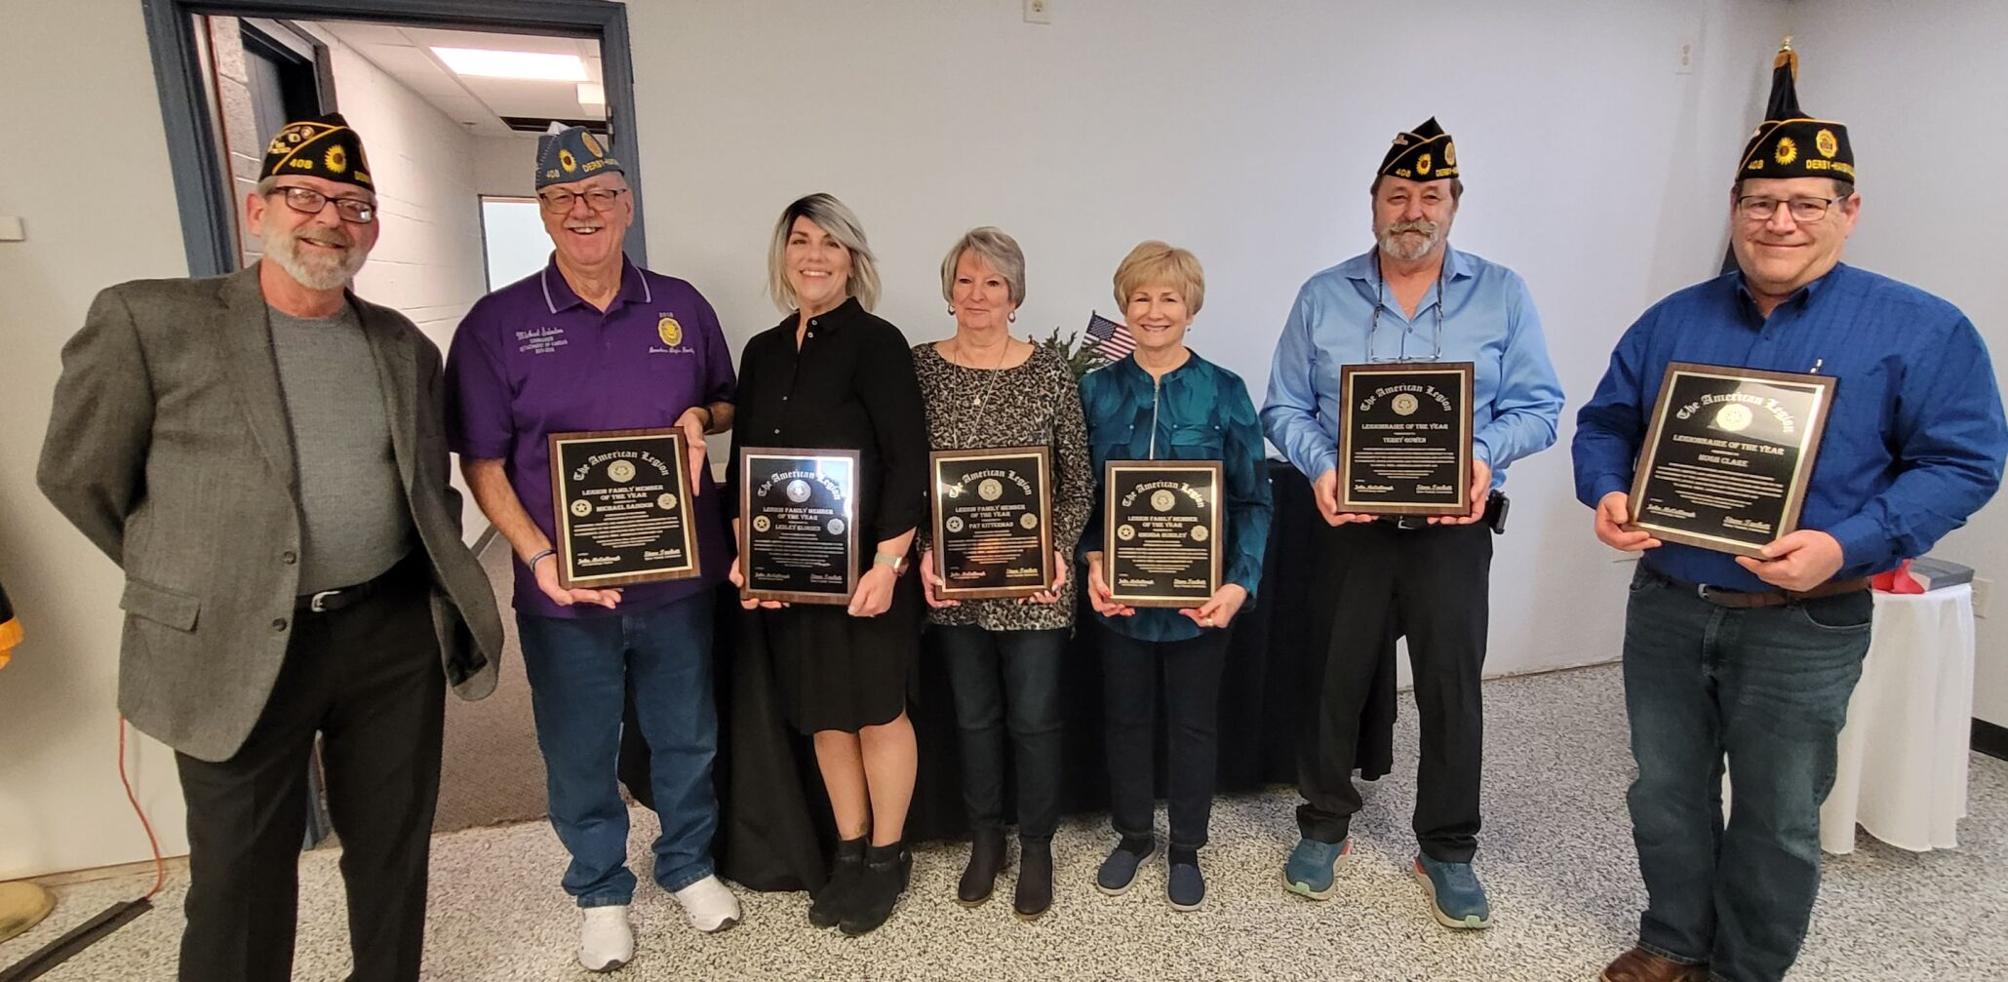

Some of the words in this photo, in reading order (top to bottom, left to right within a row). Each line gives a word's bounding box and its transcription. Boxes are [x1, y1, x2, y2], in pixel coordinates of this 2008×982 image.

[290, 158, 313, 169] 408
[1360, 395, 1376, 411] The
[1376, 383, 1423, 397] American
[1426, 385, 1452, 411] Legion
[1676, 401, 1700, 419] The
[1701, 392, 1765, 406] American
[573, 464, 590, 481] The
[588, 450, 638, 465] American
[642, 451, 670, 476] Legion
[757, 481, 772, 496] The
[771, 469, 815, 482] American
[962, 468, 1005, 483] American
[1008, 470, 1032, 496] Legion
[1122, 491, 1137, 507] The
[1136, 480, 1178, 493] American
